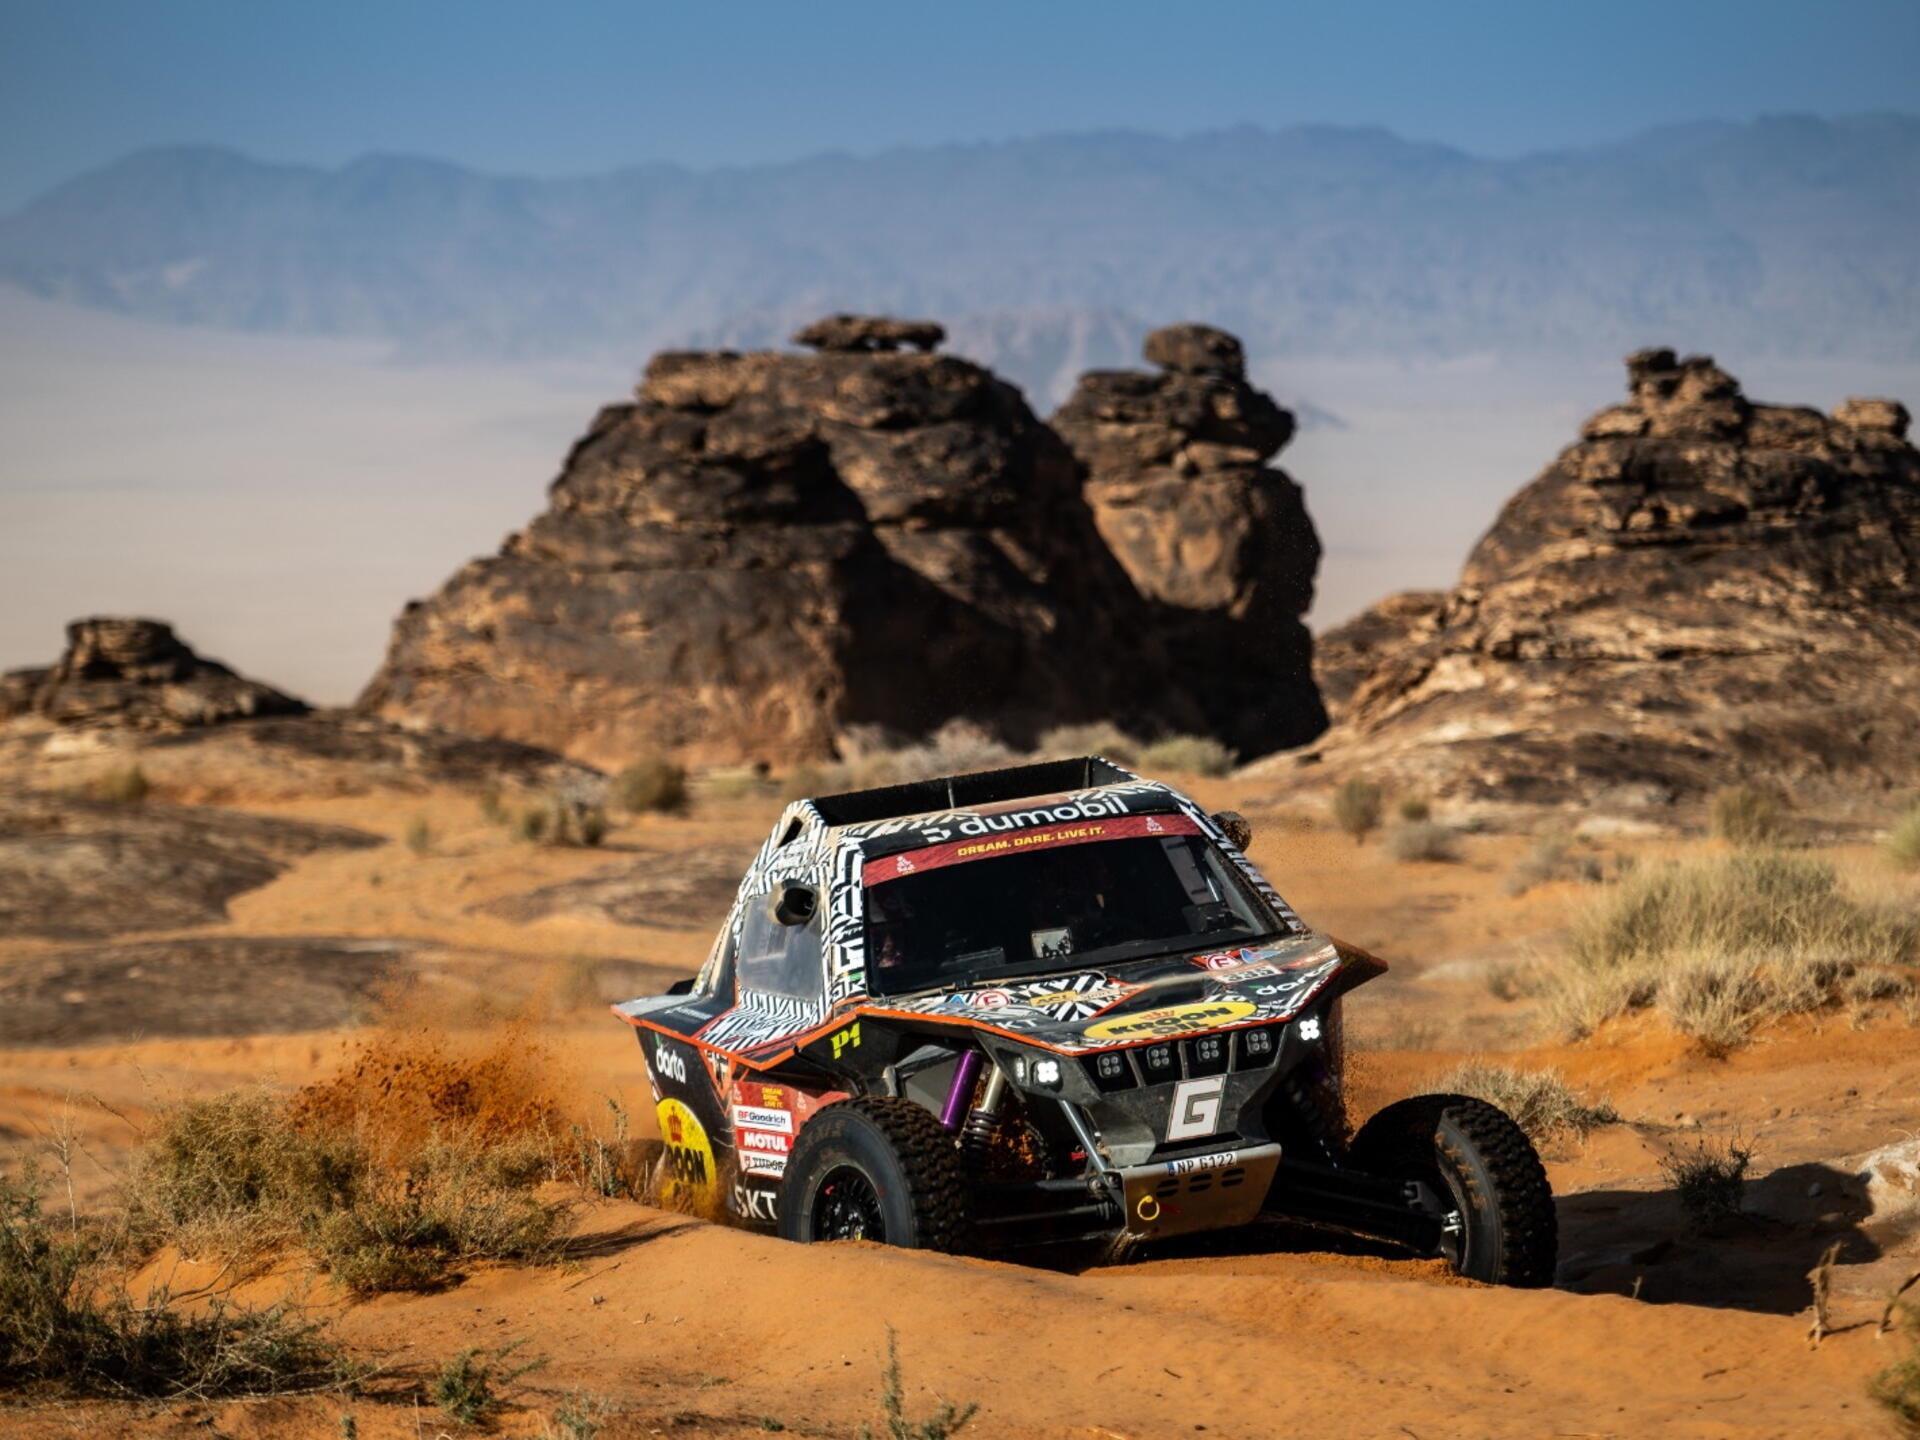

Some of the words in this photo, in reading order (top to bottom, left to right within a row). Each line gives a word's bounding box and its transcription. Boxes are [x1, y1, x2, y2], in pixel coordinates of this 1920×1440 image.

[957, 840, 1012, 856] DREAM.
[1014, 834, 1055, 847] DARE.
[1057, 829, 1087, 840] LIVE
[1089, 827, 1105, 836] IT.
[1107, 1007, 1233, 1035] KROON
[1151, 1021, 1209, 1035] OIL
[1165, 1075, 1227, 1142] G
[743, 1131, 789, 1152] MOTUL
[1177, 1160, 1194, 1173] NP
[735, 1184, 779, 1220] SKT
